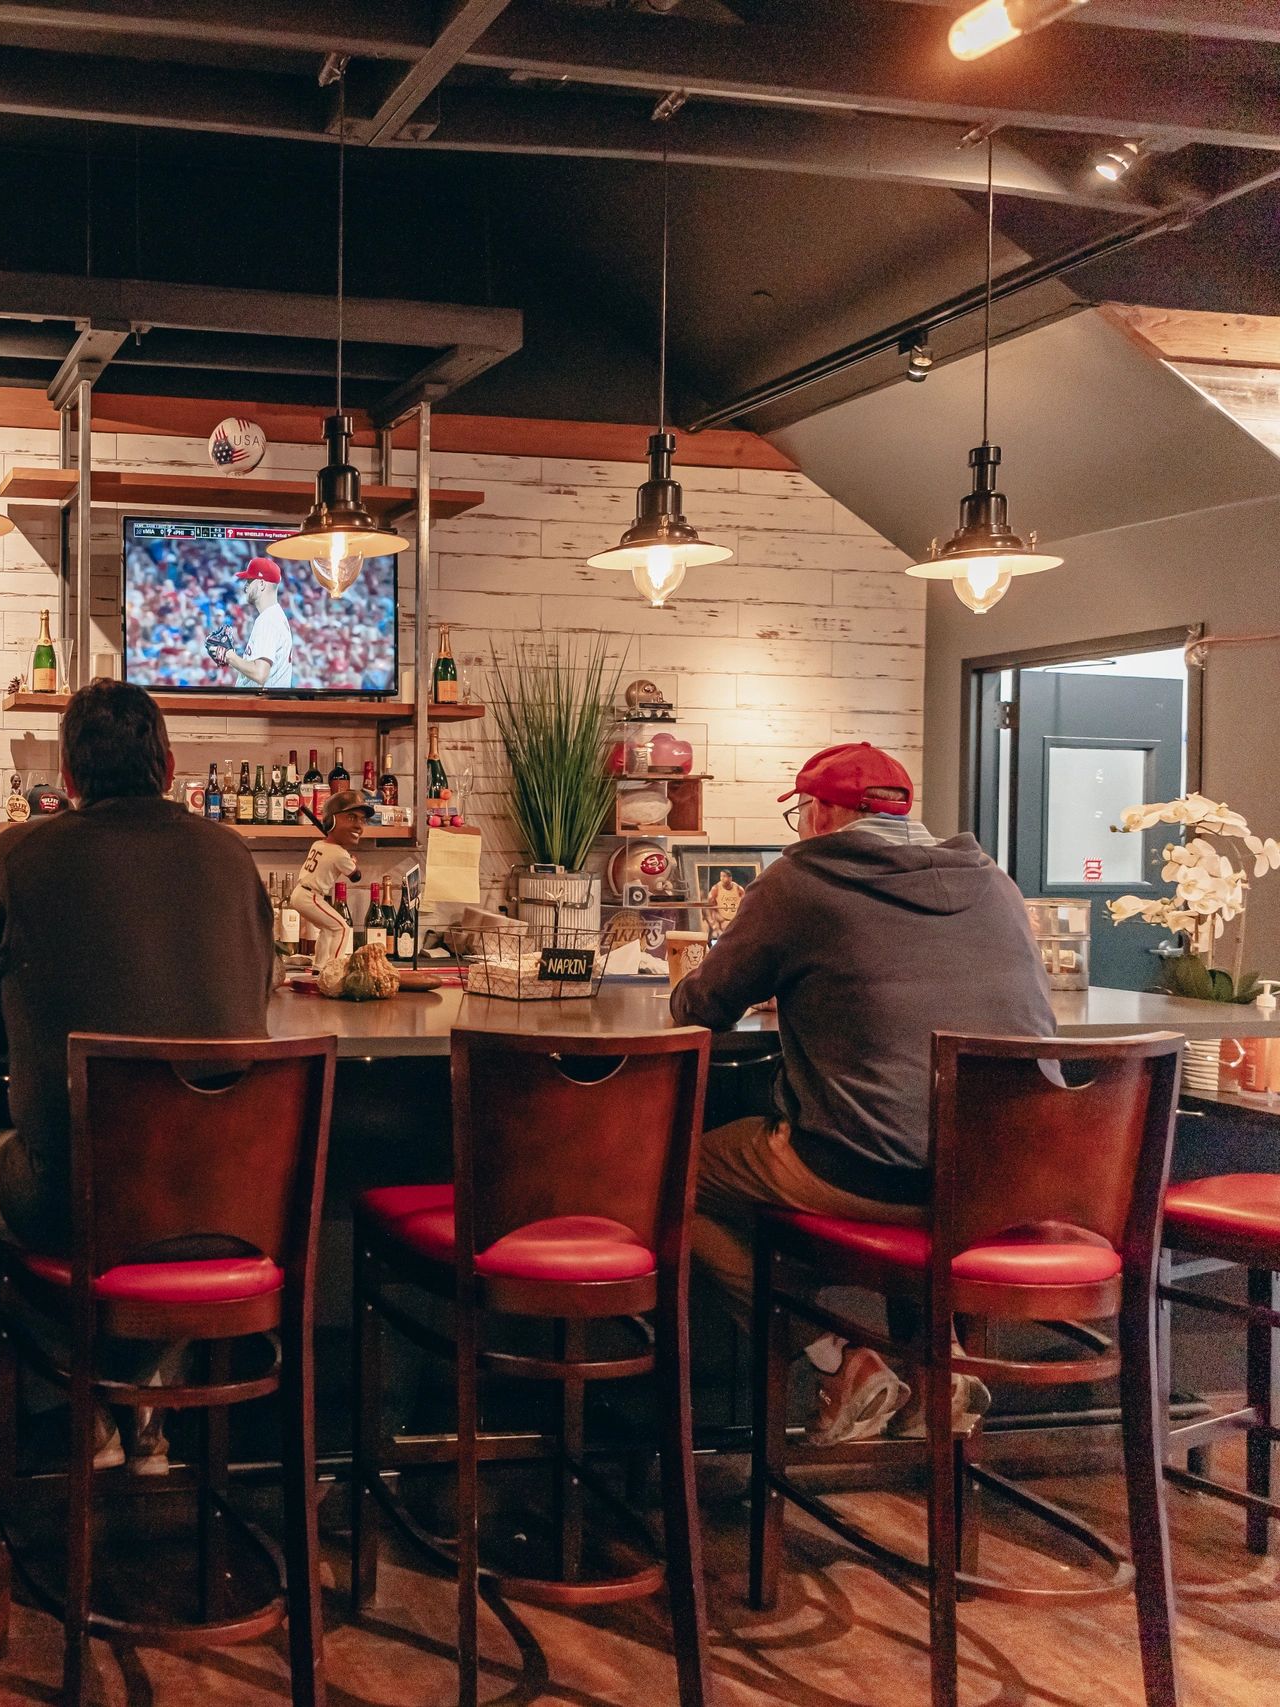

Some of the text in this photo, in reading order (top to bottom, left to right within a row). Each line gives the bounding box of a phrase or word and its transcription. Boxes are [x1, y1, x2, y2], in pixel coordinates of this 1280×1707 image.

[234, 435, 260, 446] USA
[304, 848, 323, 873] 25
[548, 958, 587, 974] NAPKIN
